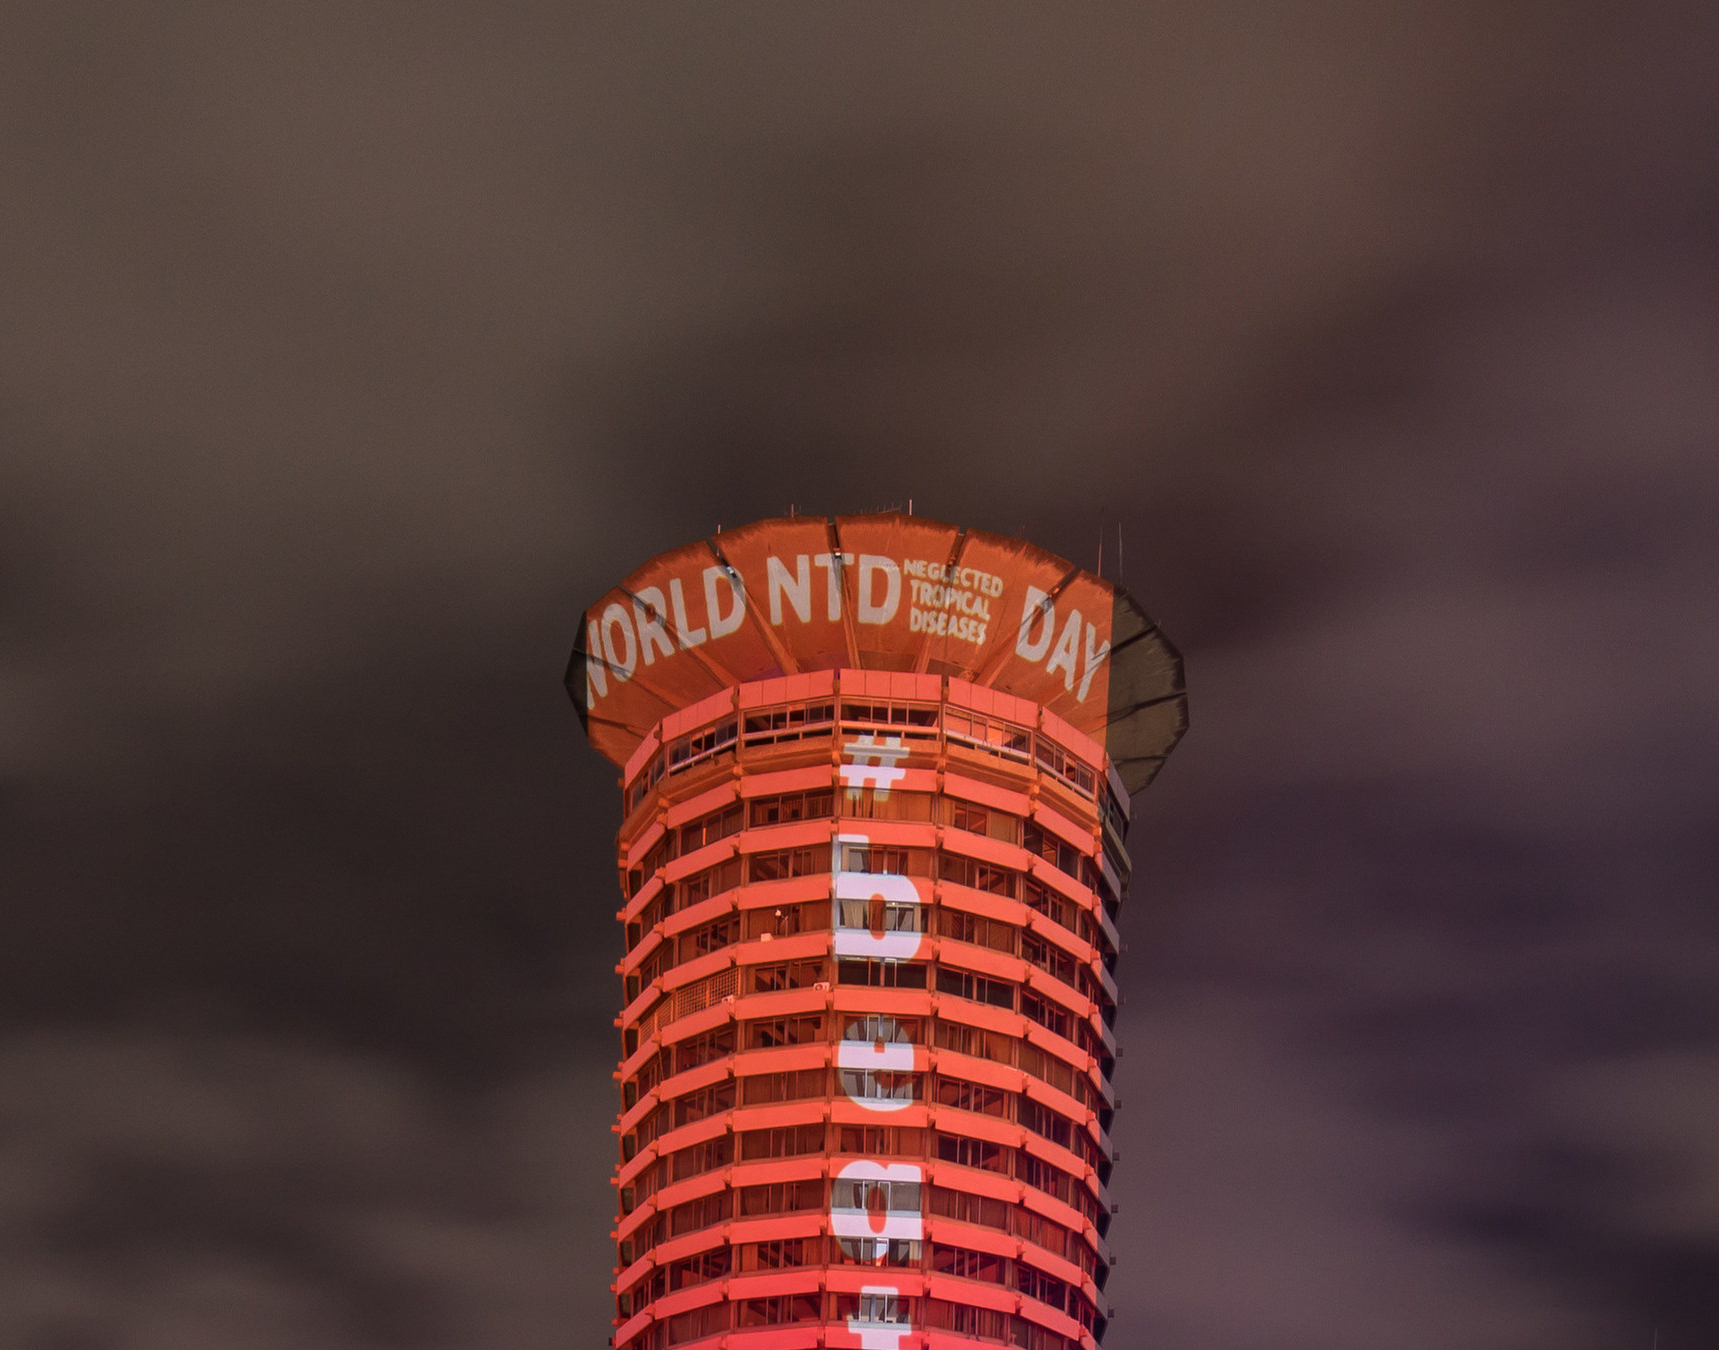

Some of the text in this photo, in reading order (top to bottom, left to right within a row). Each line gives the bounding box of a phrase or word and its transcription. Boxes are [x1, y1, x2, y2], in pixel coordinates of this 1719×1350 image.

[767, 553, 902, 625] NTD
[904, 559, 1003, 598] NEGLECTED
[910, 579, 990, 621] TROPICAL
[910, 606, 987, 645] DISEASES
[1015, 585, 1111, 702] DAY
